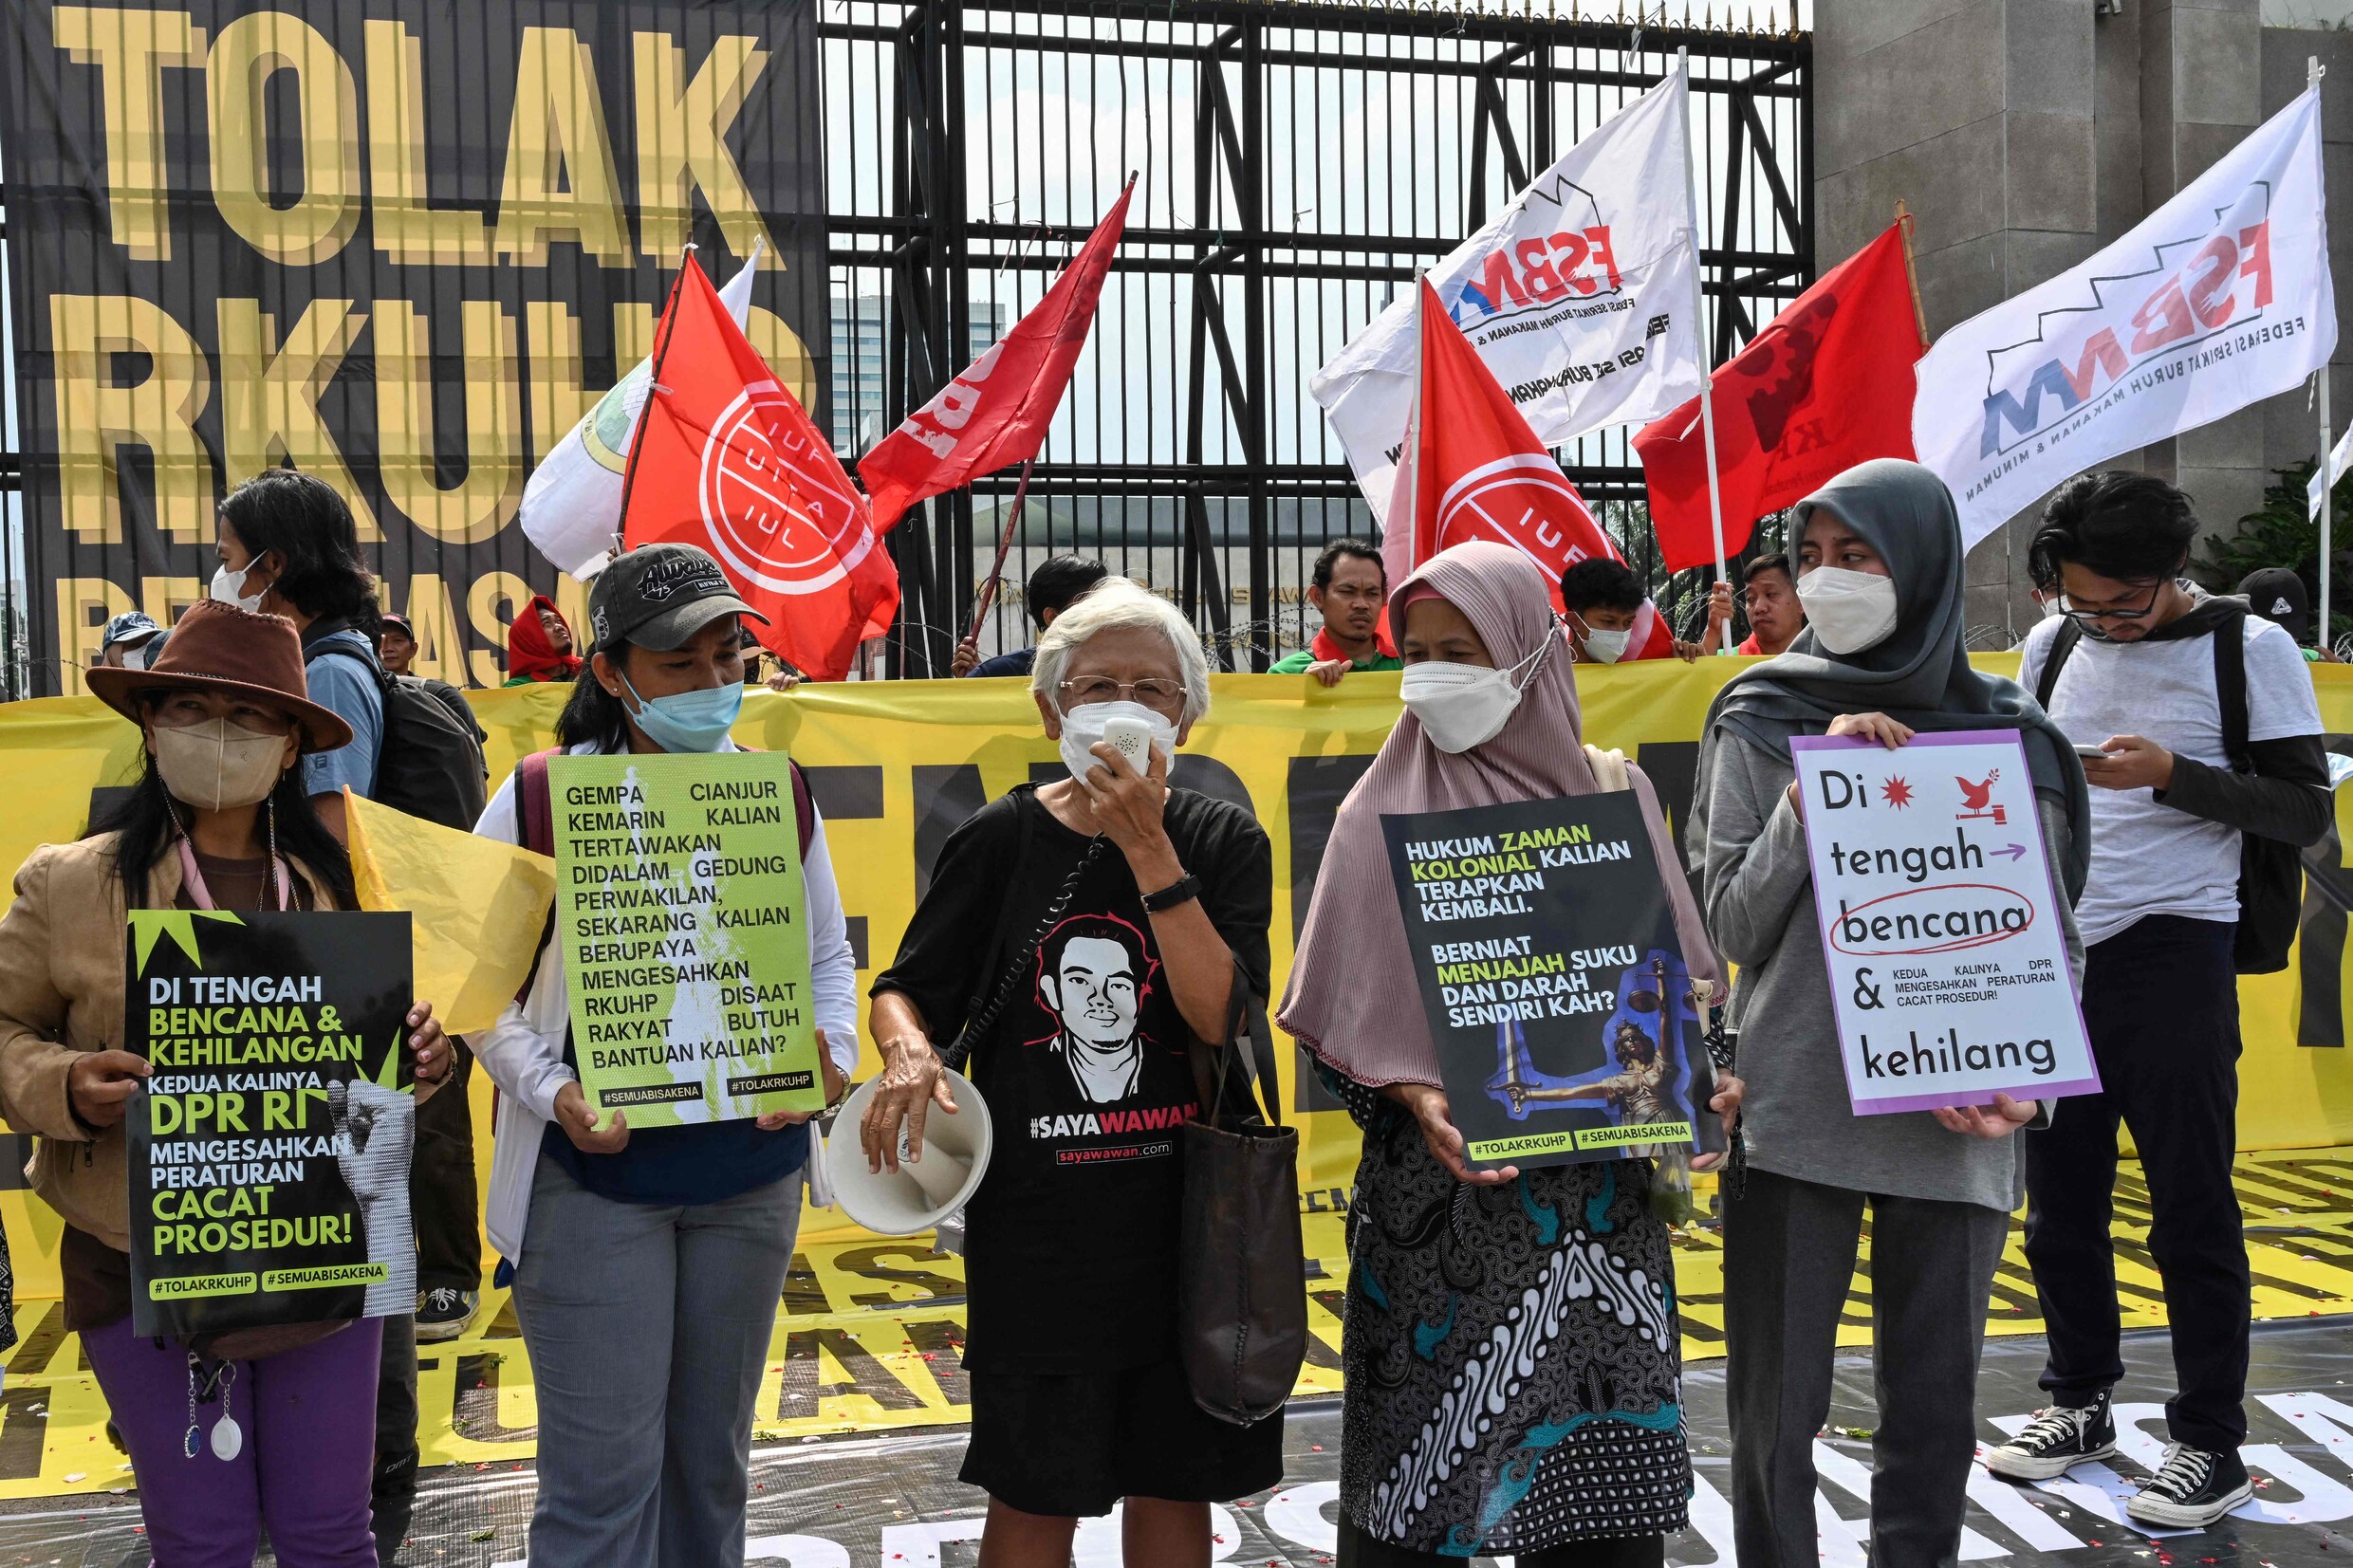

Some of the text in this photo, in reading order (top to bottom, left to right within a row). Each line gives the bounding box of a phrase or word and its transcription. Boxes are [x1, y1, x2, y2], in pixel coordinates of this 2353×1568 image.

[52, 6, 782, 269] TOLAK
[744, 505, 795, 549] IUL
[566, 782, 777, 805] GEMPA CIANJUR
[1819, 770, 1868, 809] Di
[568, 806, 781, 831] KEMARIN KALIAN
[569, 834, 721, 858] TERTAWAKAN
[1405, 824, 1591, 861] HUKUM ZAMAN
[1831, 827, 1983, 883] tengah
[573, 856, 786, 884] DIDALAM GEDUNG
[1410, 840, 1631, 880] KOLONIAL KALIAN
[574, 886, 723, 911] PERWAKILAN,
[1415, 872, 1545, 901] TERAPKAN
[577, 907, 789, 937] SEKARANG KALIAN
[1420, 895, 1533, 922] KEMBALI.
[1839, 899, 2028, 943] bencana
[579, 939, 696, 964] BERUPAYA
[1431, 936, 1531, 964] BERNIAT
[1436, 945, 1638, 985] MENJAJAH SUKU
[582, 961, 750, 989] MENGESAHKAN
[1893, 959, 2052, 980] KEDUA KALINYA DPR
[1895, 972, 2055, 993] MENGESAHKAN PERATURAN
[149, 975, 322, 1005] DI TENGAH
[584, 984, 796, 1016] RKUHP DISAAT
[1441, 972, 1590, 1006] DAN DARAH
[1853, 967, 1885, 1010] &
[1897, 990, 1997, 1006] CACAT PROSEDUR!
[149, 1005, 343, 1035] BENCANA &
[1449, 991, 1614, 1027] SENDIRI KAH?
[588, 1008, 800, 1043] RAKYAT BUTUH
[149, 1034, 362, 1067] KEHILANGAN
[591, 1035, 787, 1069] BANTUAN KALIAN?
[1861, 1028, 2057, 1079] kehilang
[148, 1071, 323, 1095] KEDUA KALINYA
[604, 1074, 810, 1103] #SEMUABISAKENA #TOLAKRKUHP
[149, 1088, 306, 1135] DPR RI
[1030, 1102, 1197, 1138] #SAYAWAWAN
[150, 1135, 351, 1165] MENGESAHKAN
[1059, 1142, 1169, 1163] sayawawan.com
[1474, 1125, 1688, 1154] #TOLAKRKUHP #SEMUABISAKENA
[151, 1161, 305, 1190] PERATURAN
[152, 1186, 274, 1221] CACAT
[154, 1213, 351, 1256] PROSEDUR!
[155, 1266, 383, 1294] #TOLAKRKUHP #SEMUABISAKENA
